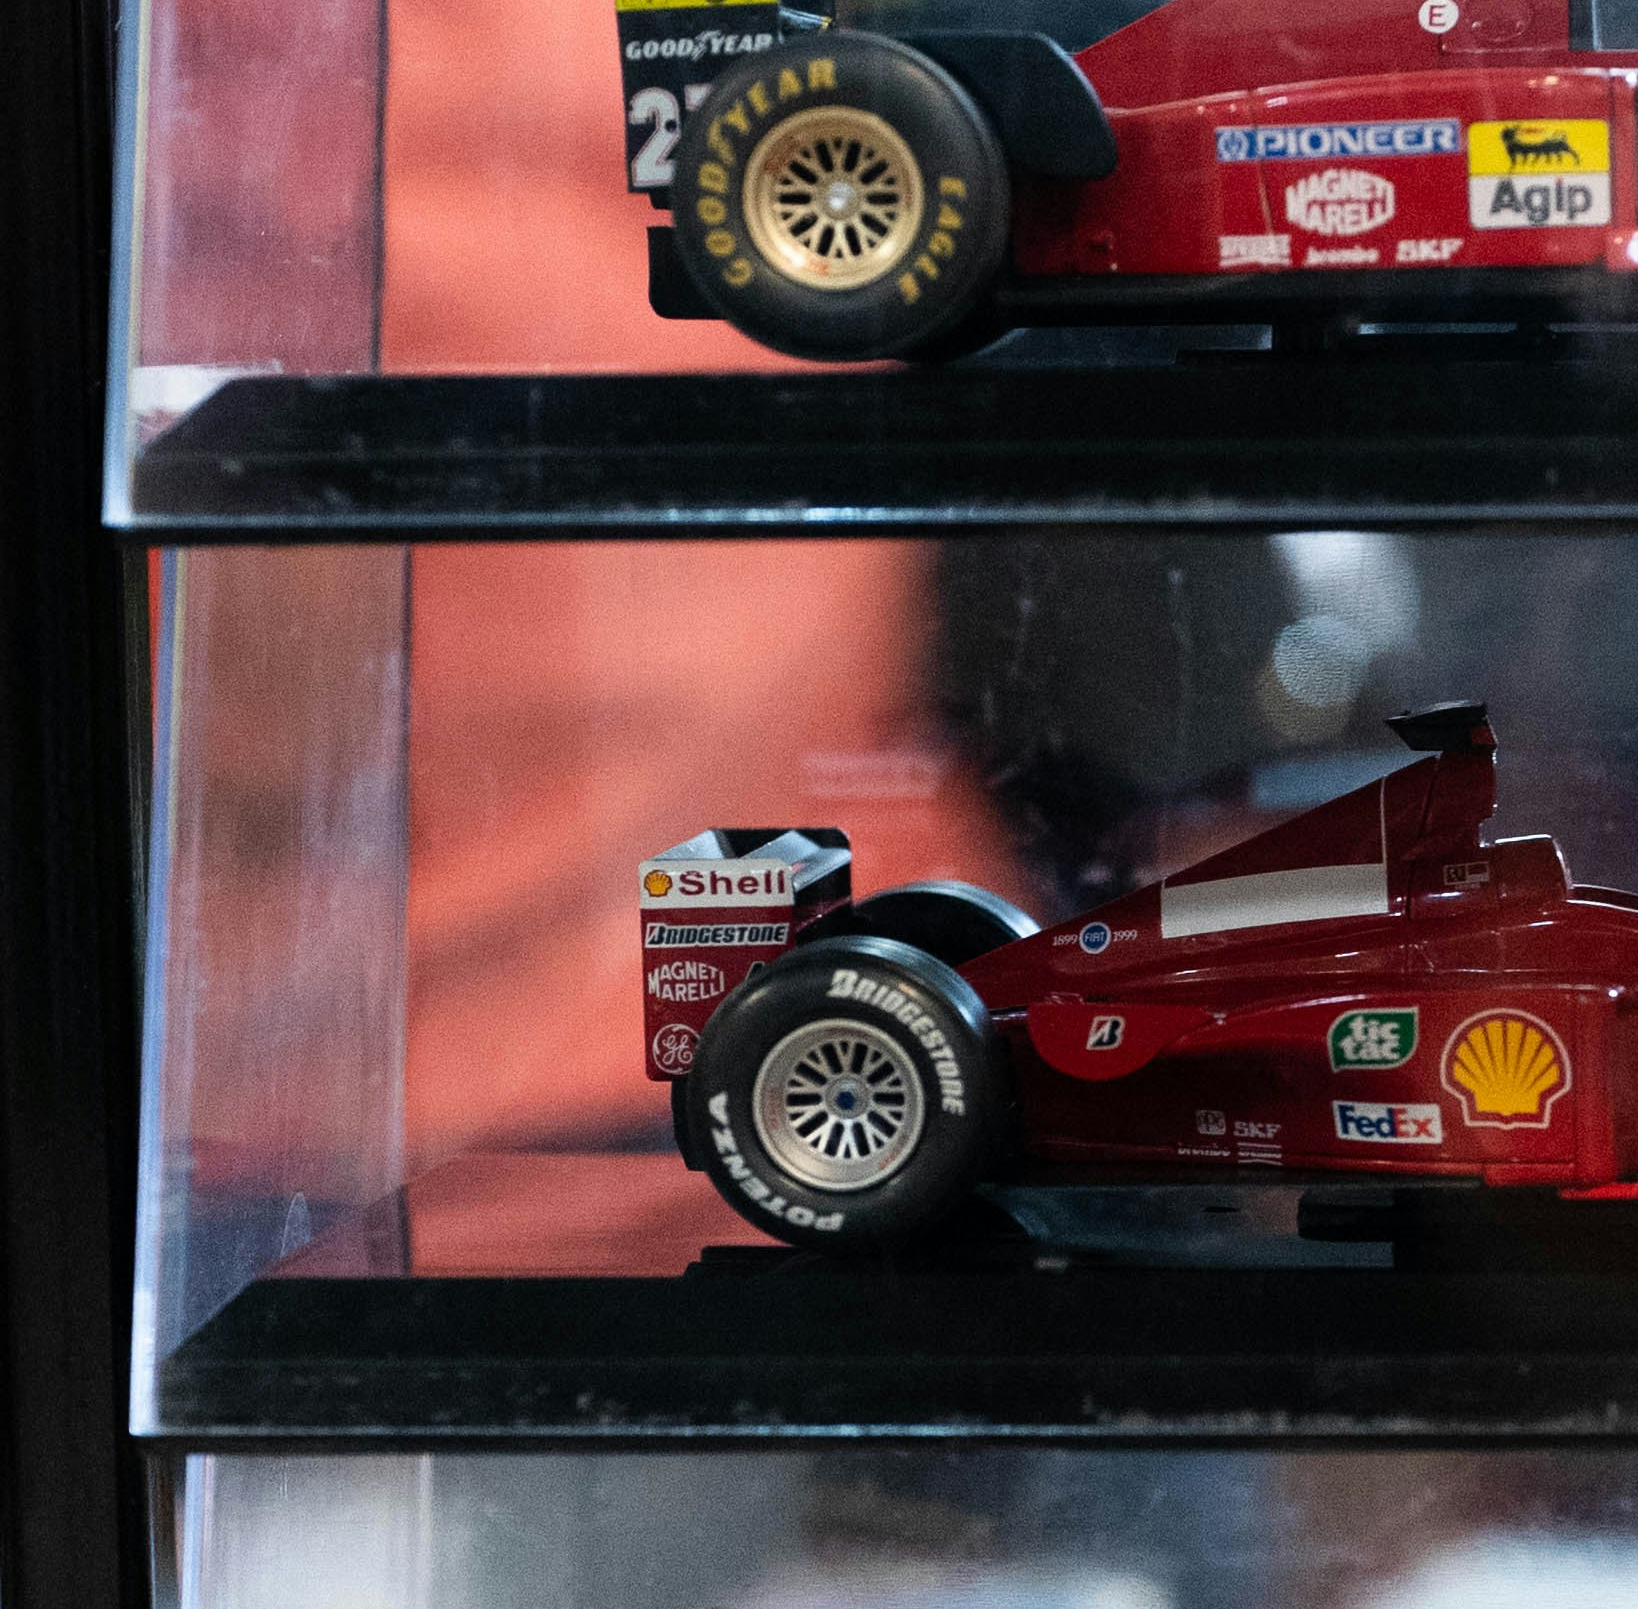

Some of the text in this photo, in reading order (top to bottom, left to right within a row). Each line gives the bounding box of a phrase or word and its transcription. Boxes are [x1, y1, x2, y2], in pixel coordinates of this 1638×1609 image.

[1428, 4, 1447, 27] E
[625, 31, 773, 61] GOODYEAR
[628, 83, 713, 190] 2
[1256, 124, 1456, 158] PIONEER
[1489, 176, 1595, 223] Agip
[678, 870, 787, 896] Shell
[645, 923, 789, 947] BRIDGESTONE
[647, 961, 725, 984] MAGNETI
[1348, 1015, 1401, 1041] tic
[1338, 1034, 1401, 1062] tac
[1337, 1103, 1435, 1138] FedEx
